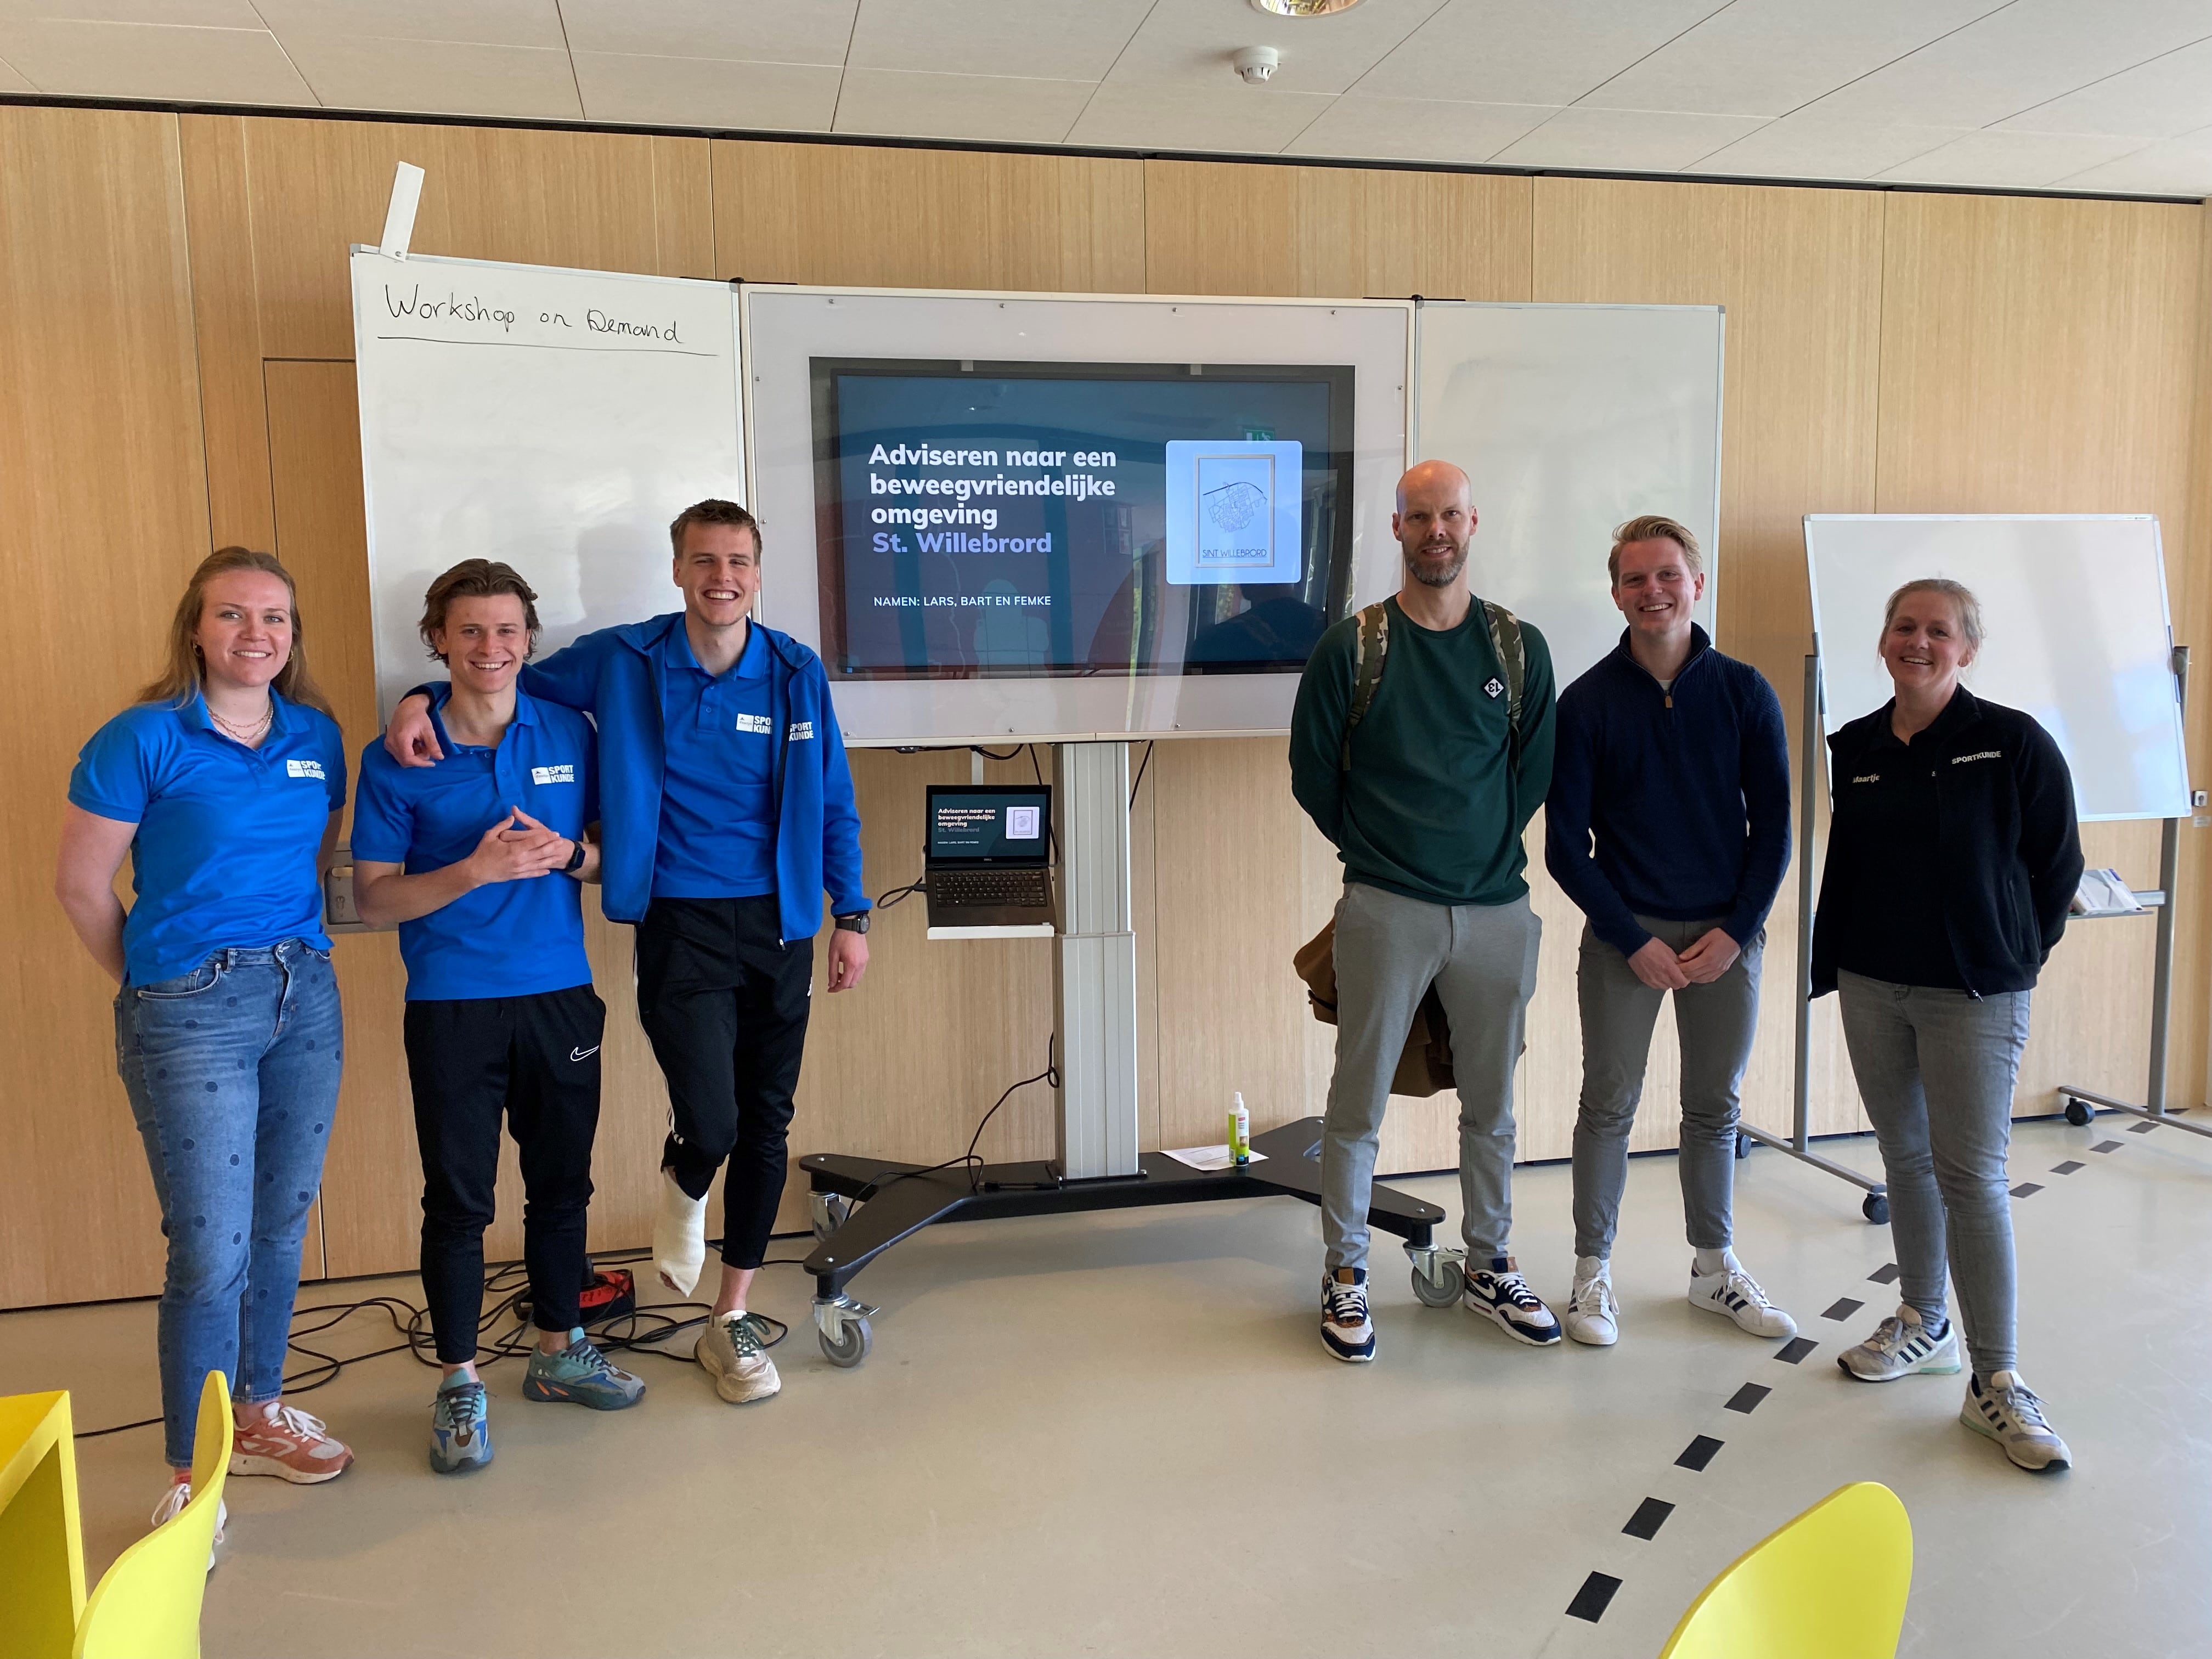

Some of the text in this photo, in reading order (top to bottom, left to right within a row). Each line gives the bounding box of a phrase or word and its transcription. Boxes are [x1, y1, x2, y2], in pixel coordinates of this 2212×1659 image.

[385, 284, 685, 344] Workshop on Demand
[868, 443, 1116, 467] Adviseren naar een
[870, 473, 1115, 501] beweegvriendelijke
[871, 503, 997, 530] omgeving
[873, 532, 1052, 553] St. Willebrord
[874, 596, 1051, 607] NAMEN: LARS, BART EN FEMKE
[754, 715, 772, 726] SPO
[753, 724, 772, 734] KUN
[1951, 751, 2001, 764] SPORTKUNDE
[549, 765, 573, 775] SPORT
[550, 774, 574, 783] KUNDE
[1852, 773, 1880, 783] Maartje
